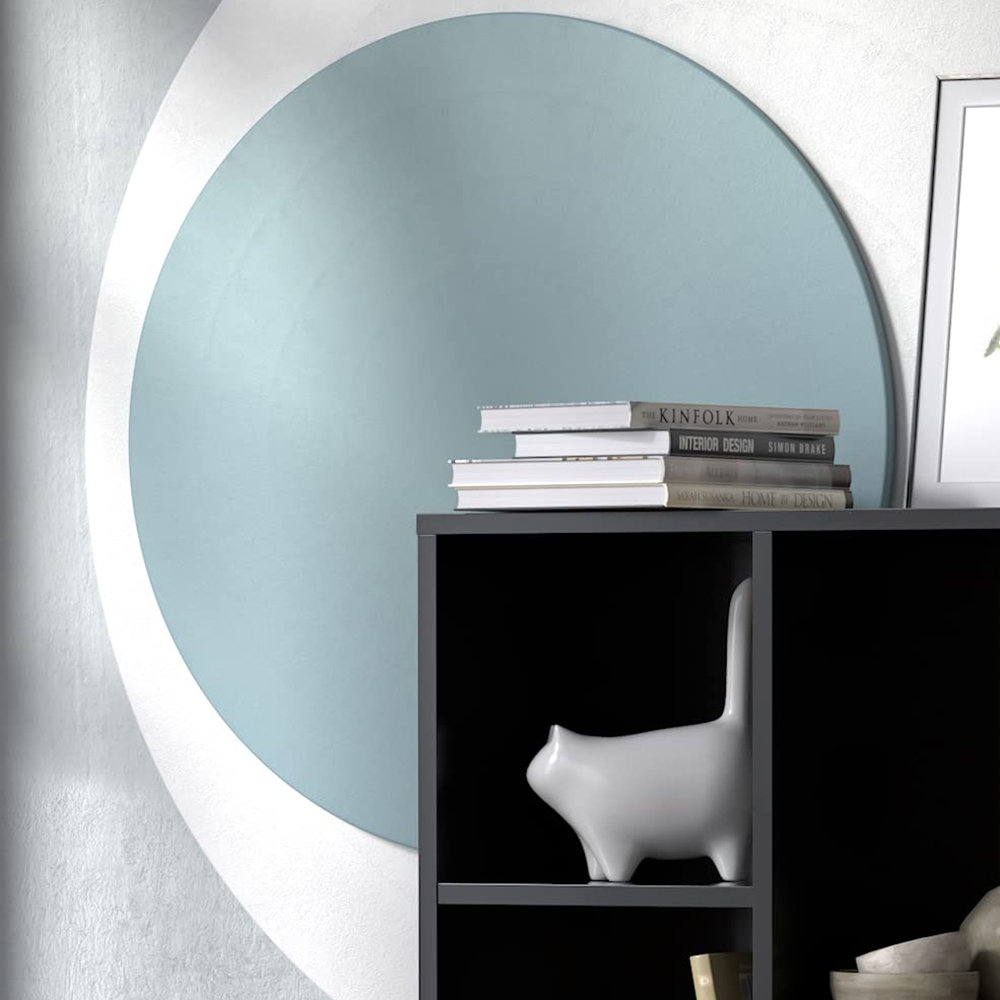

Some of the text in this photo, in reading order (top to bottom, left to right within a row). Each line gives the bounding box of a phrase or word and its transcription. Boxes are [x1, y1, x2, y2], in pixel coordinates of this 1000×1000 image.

[660, 408, 735, 426] KINFOLK
[679, 435, 827, 455] INTERIOR DESIGN SIMON BRAKE
[742, 490, 776, 506] HOME
[794, 492, 833, 508] DESIGN
